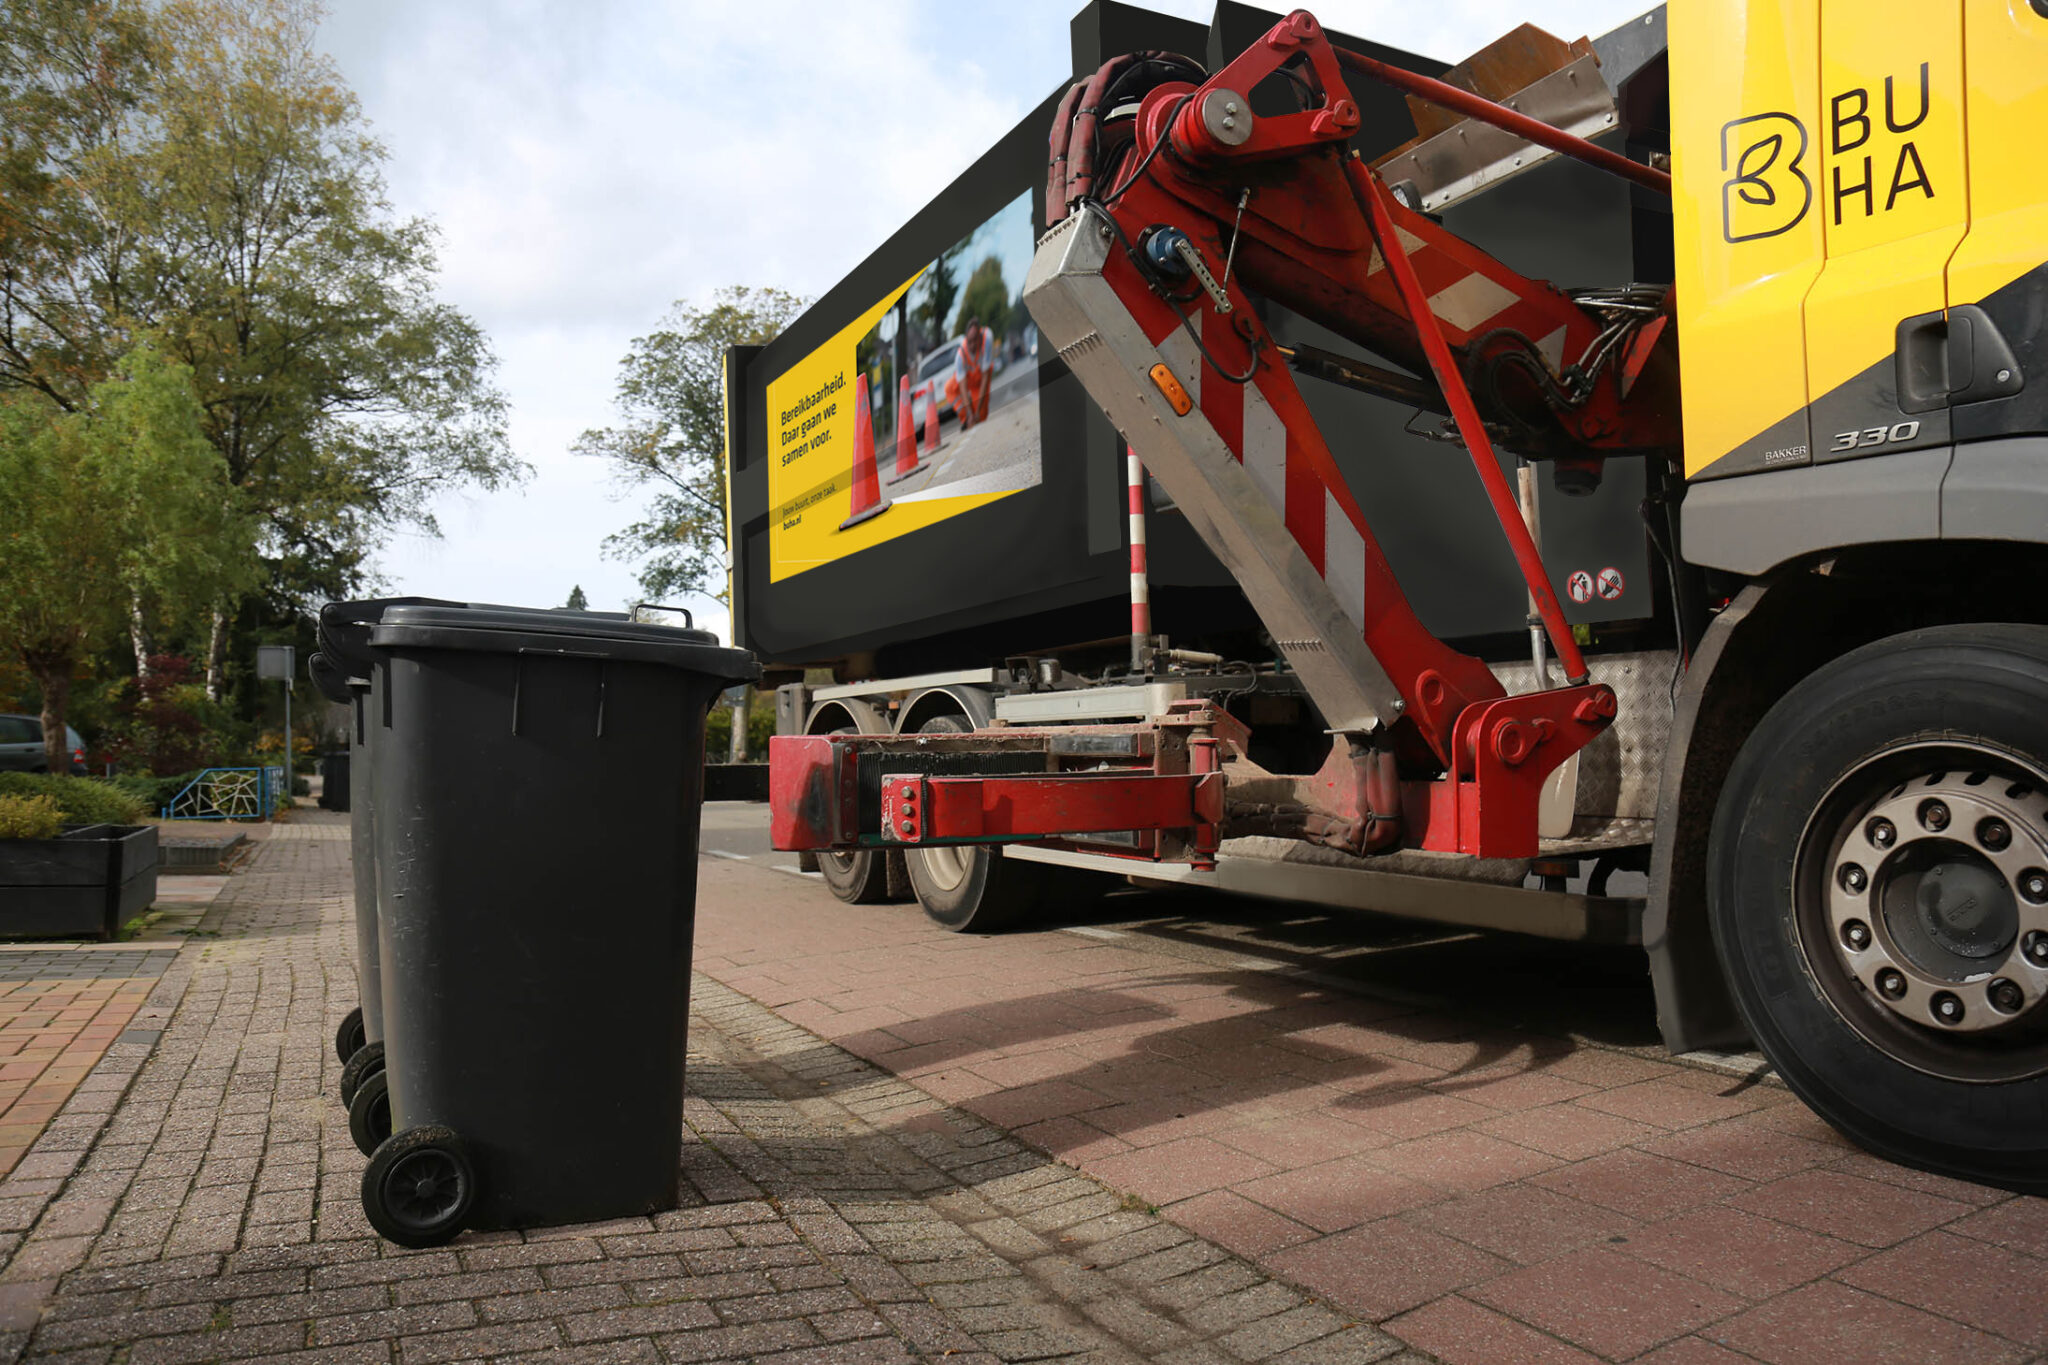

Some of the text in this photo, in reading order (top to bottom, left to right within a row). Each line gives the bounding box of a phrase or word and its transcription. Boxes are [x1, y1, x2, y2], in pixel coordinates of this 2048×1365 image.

[1830, 61, 1930, 156] BU
[1833, 141, 1935, 226] HA
[781, 371, 846, 426] Bereikbaarheid.
[781, 403, 837, 446] Daar gaan we
[1830, 421, 1921, 453] 330
[782, 429, 832, 467] samen voor.
[1765, 445, 1806, 461] BAKKER
[783, 514, 802, 531] buha.nl
